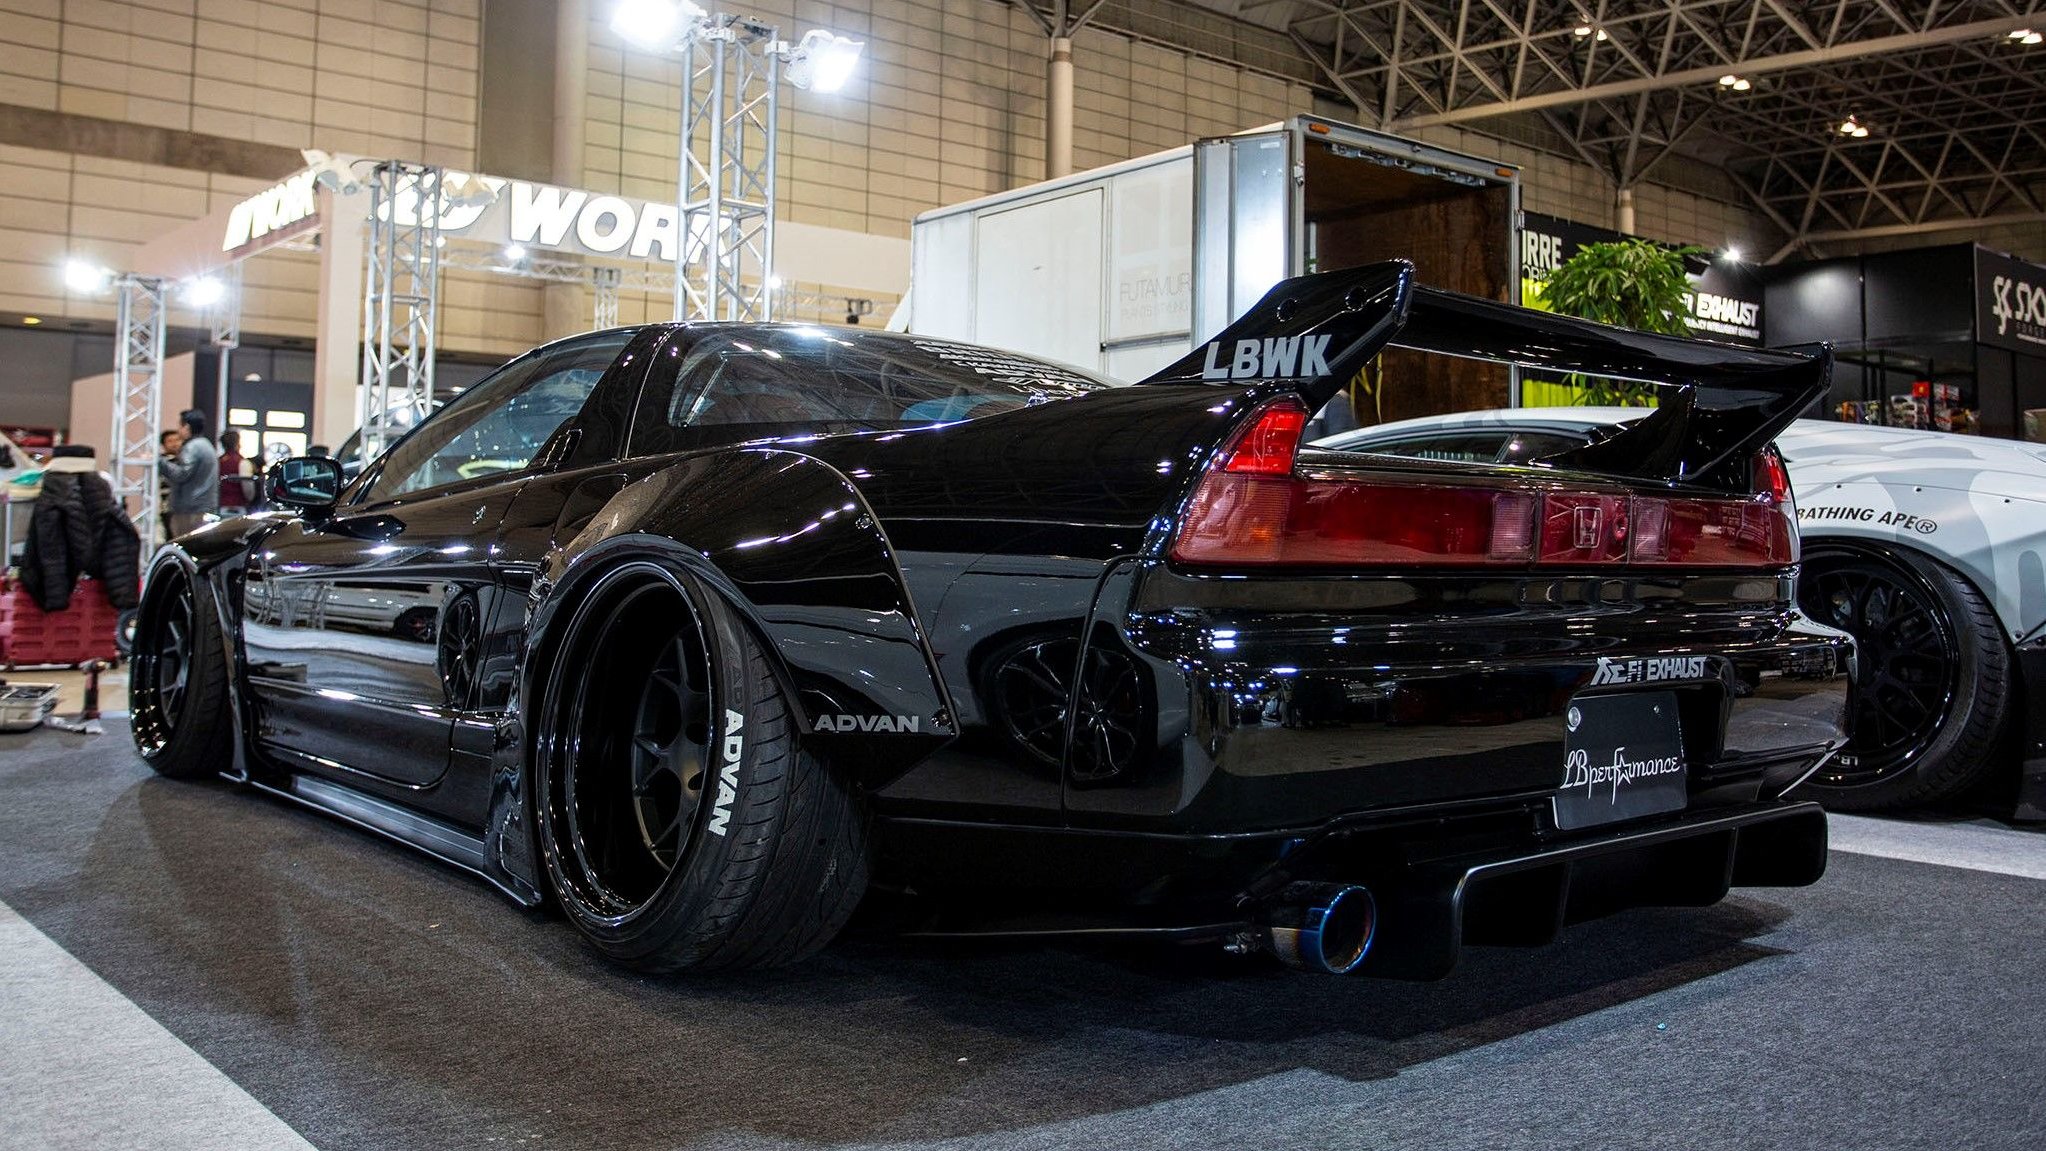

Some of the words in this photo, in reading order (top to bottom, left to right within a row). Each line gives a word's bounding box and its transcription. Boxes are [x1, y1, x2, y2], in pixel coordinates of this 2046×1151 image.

[510, 181, 733, 267] WORK
[1697, 293, 1760, 327] EXHAUST
[1202, 334, 1332, 379] LBWK
[1797, 507, 1875, 521] BATHING
[1647, 657, 1707, 680] EXHAUST
[814, 714, 919, 732] ADVAN
[708, 709, 744, 836] ADVAN
